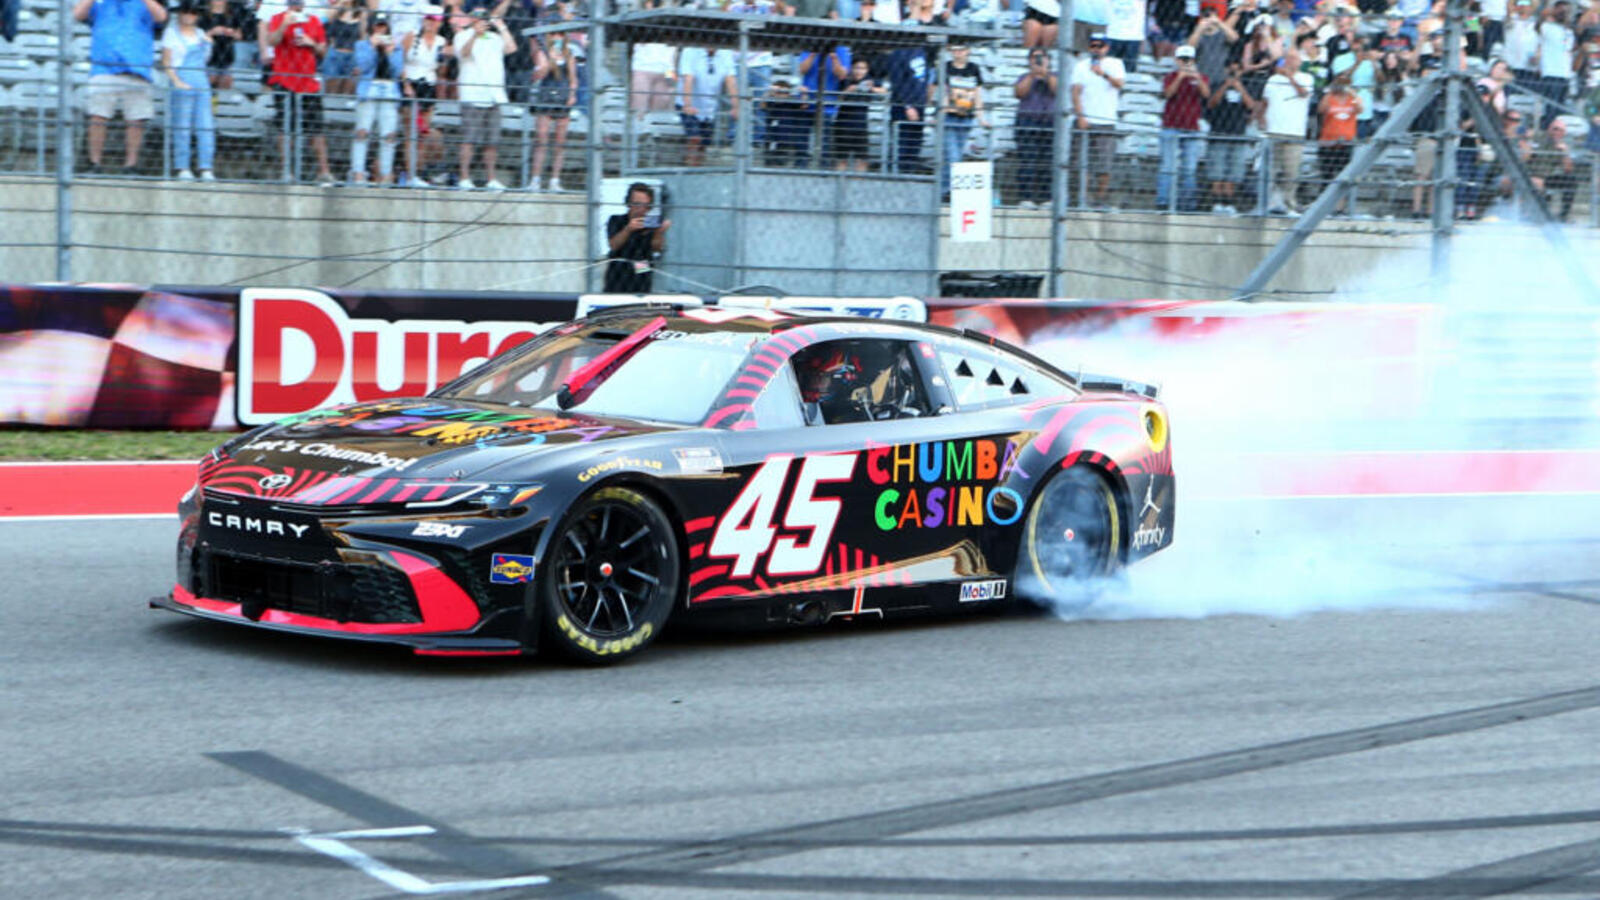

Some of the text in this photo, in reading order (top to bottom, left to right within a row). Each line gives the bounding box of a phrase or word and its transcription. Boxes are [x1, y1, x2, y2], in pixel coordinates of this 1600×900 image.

[962, 210, 977, 233] F
[865, 438, 1030, 485] CHUMBA
[708, 451, 860, 580] 45
[874, 486, 1024, 531] CASINO
[208, 512, 310, 538] CAMRY
[1132, 523, 1165, 551] xfinity
[962, 583, 992, 599] Mobil
